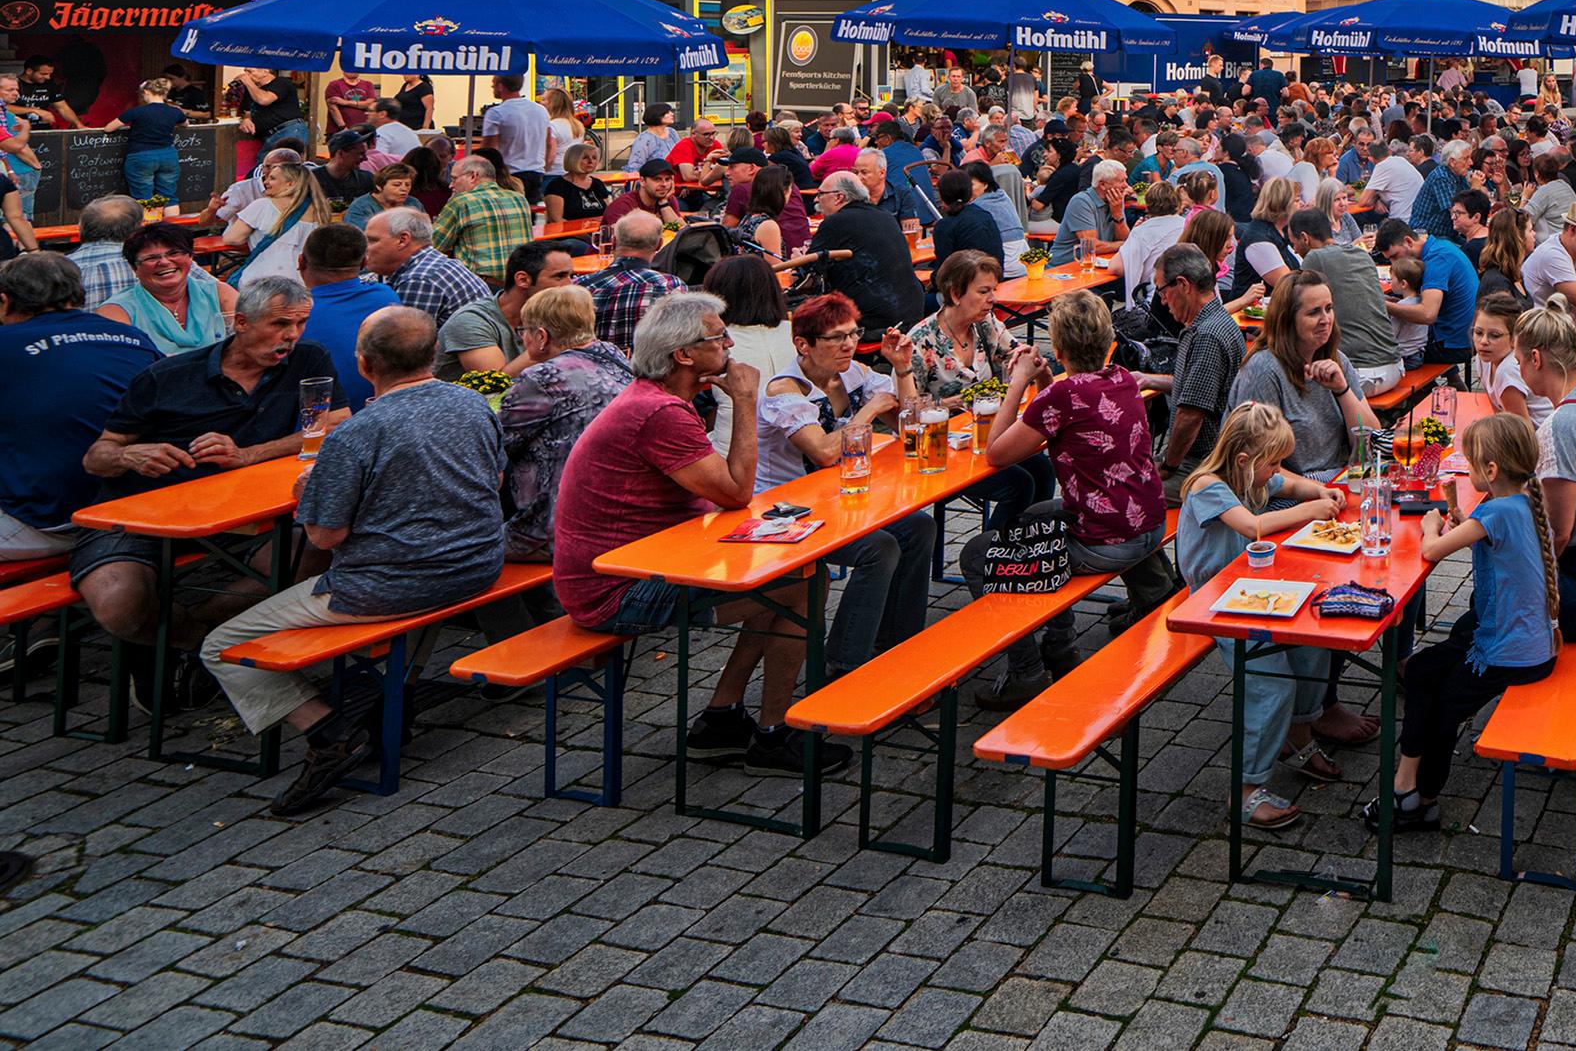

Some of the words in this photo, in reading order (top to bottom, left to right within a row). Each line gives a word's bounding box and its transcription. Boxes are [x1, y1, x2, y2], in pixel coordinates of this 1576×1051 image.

[50, 2, 223, 31] Jägermeist
[837, 19, 891, 42] Hofmühl
[1016, 26, 1107, 50] Hofmühl
[1311, 30, 1372, 48] Hofmühl
[354, 42, 512, 71] Hofmühl
[678, 43, 719, 70] ofmühl
[789, 81, 842, 90] Sportlerküche
[823, 71, 851, 79] Kitchen
[172, 133, 202, 148] hots
[25, 339, 49, 355] SV
[51, 332, 141, 346] Pfaffenhofen
[995, 560, 1039, 576] BERLIN
